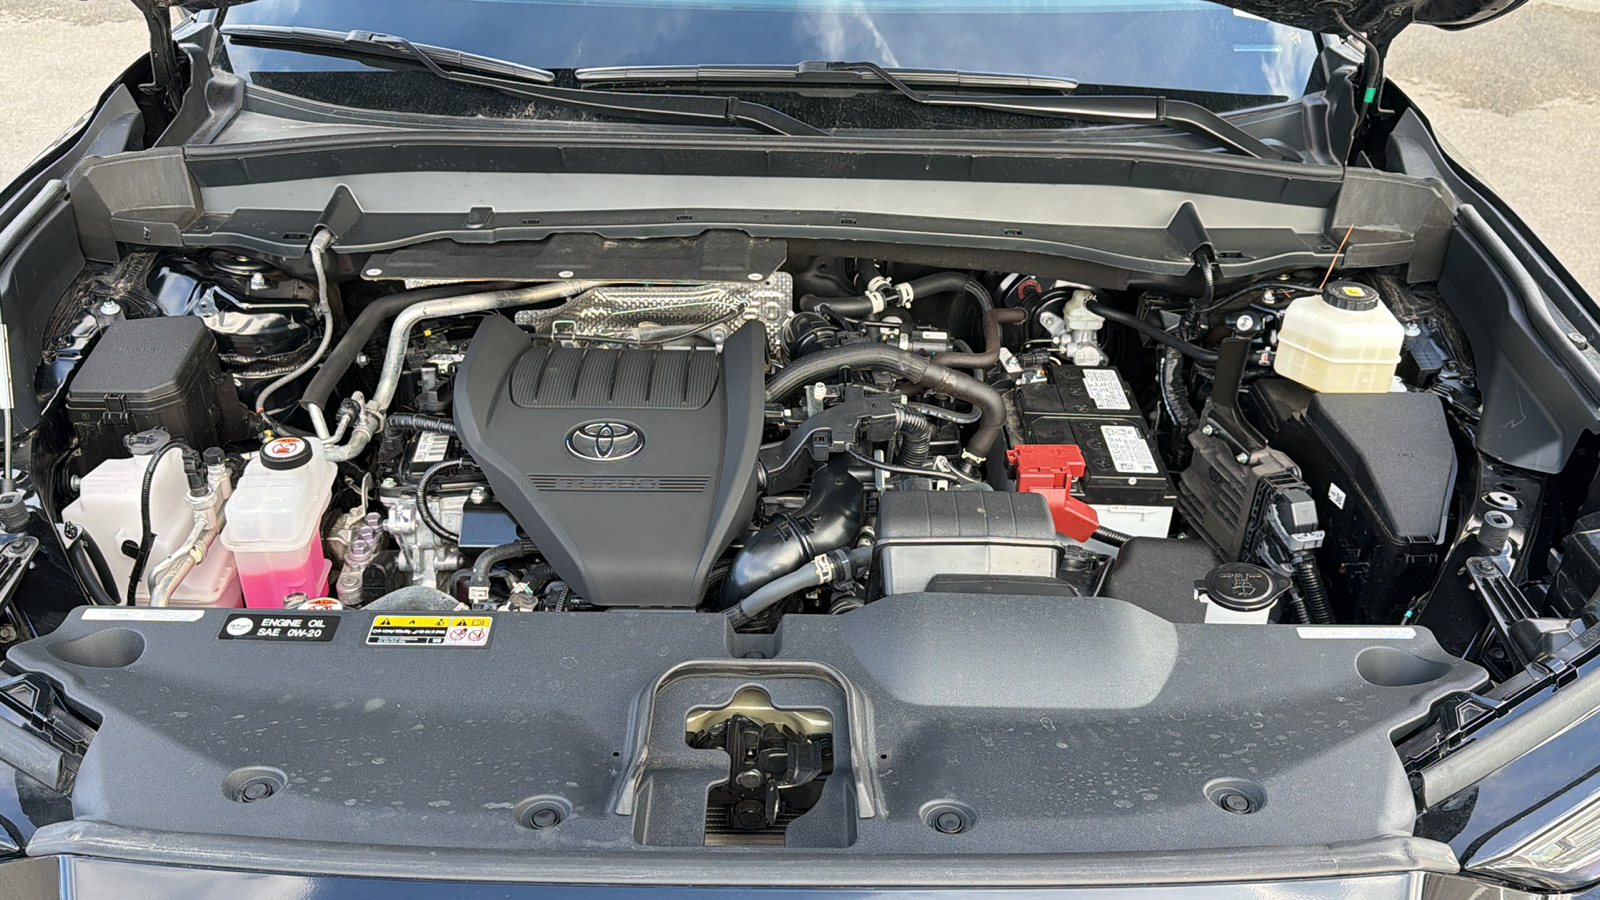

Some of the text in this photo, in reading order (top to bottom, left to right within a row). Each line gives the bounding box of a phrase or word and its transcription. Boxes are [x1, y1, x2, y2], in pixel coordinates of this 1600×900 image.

[559, 477, 656, 490] TURBO
[261, 618, 326, 628] ENGINE OIL
[257, 628, 322, 638] SAE 0W-20
